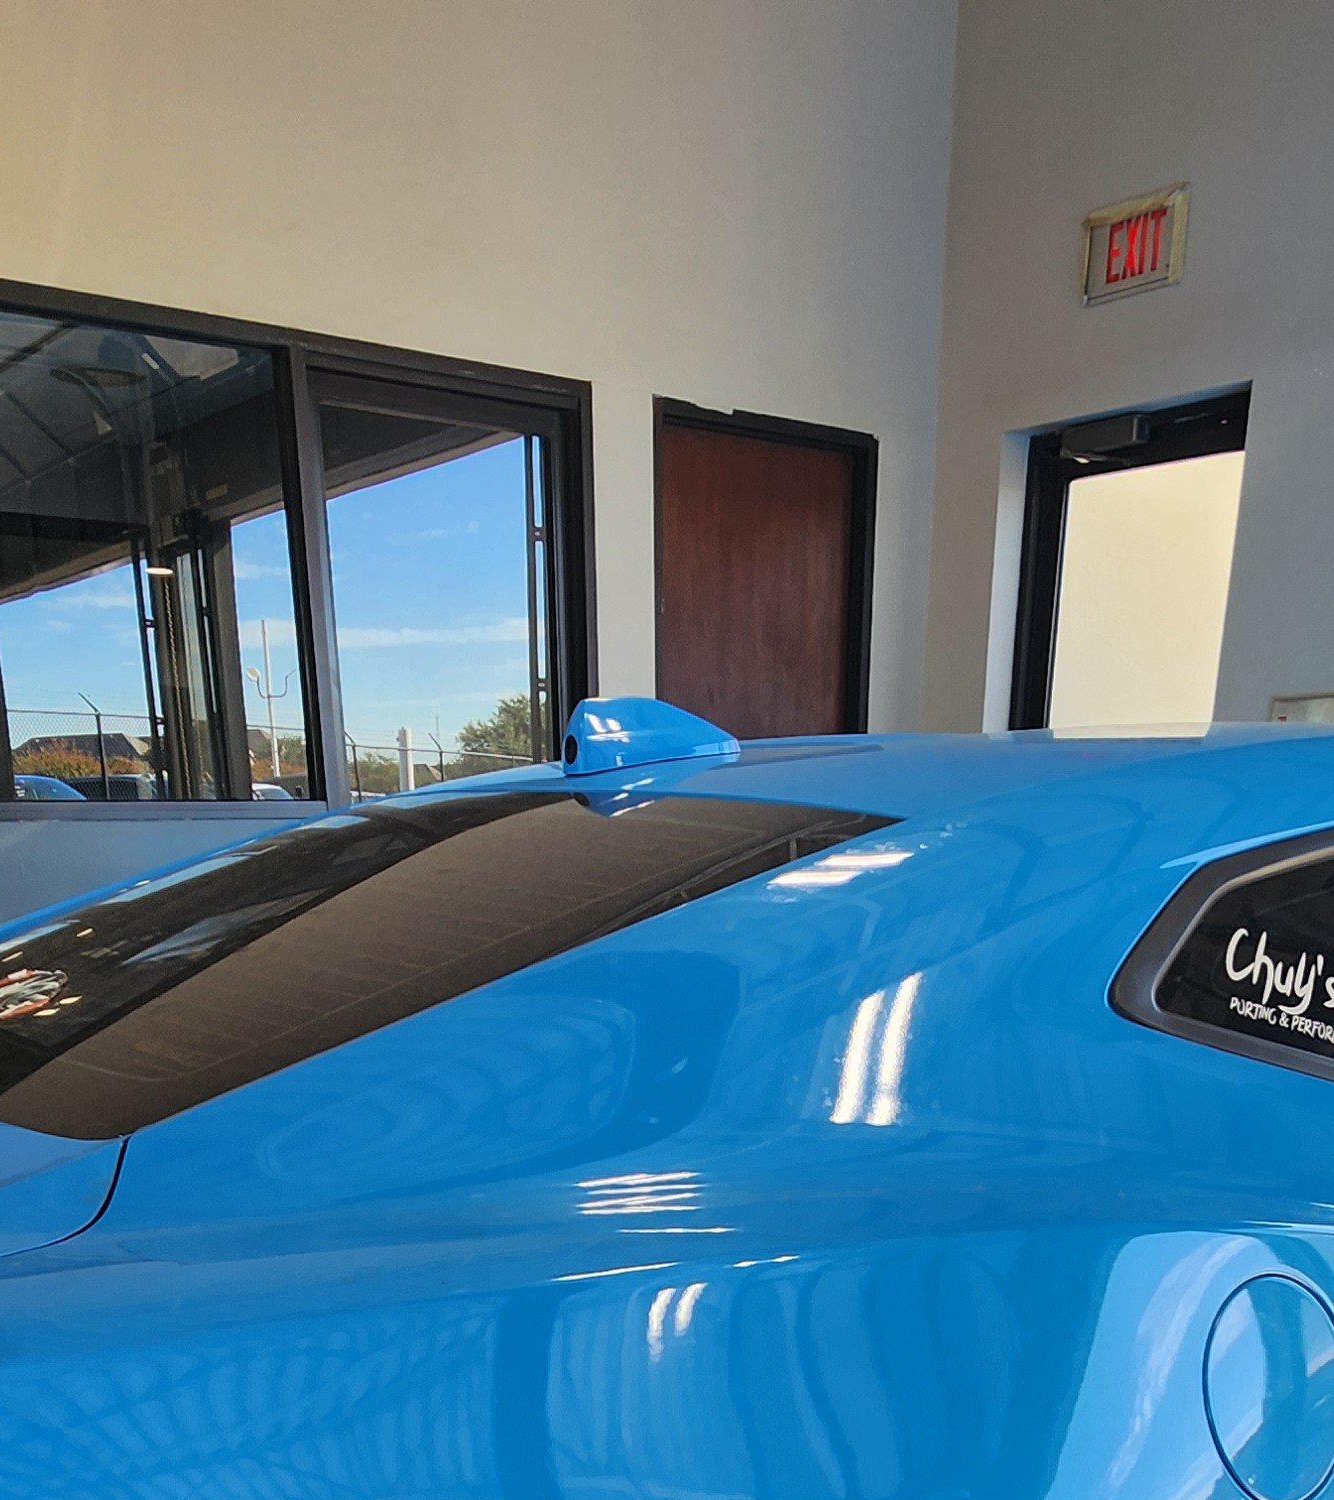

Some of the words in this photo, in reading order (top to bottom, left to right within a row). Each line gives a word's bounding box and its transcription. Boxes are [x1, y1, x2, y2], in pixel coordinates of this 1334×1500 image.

[1106, 207, 1168, 284] EXIT
[1230, 997, 1277, 1025] PORTING
[1279, 1012, 1290, 1028] &
